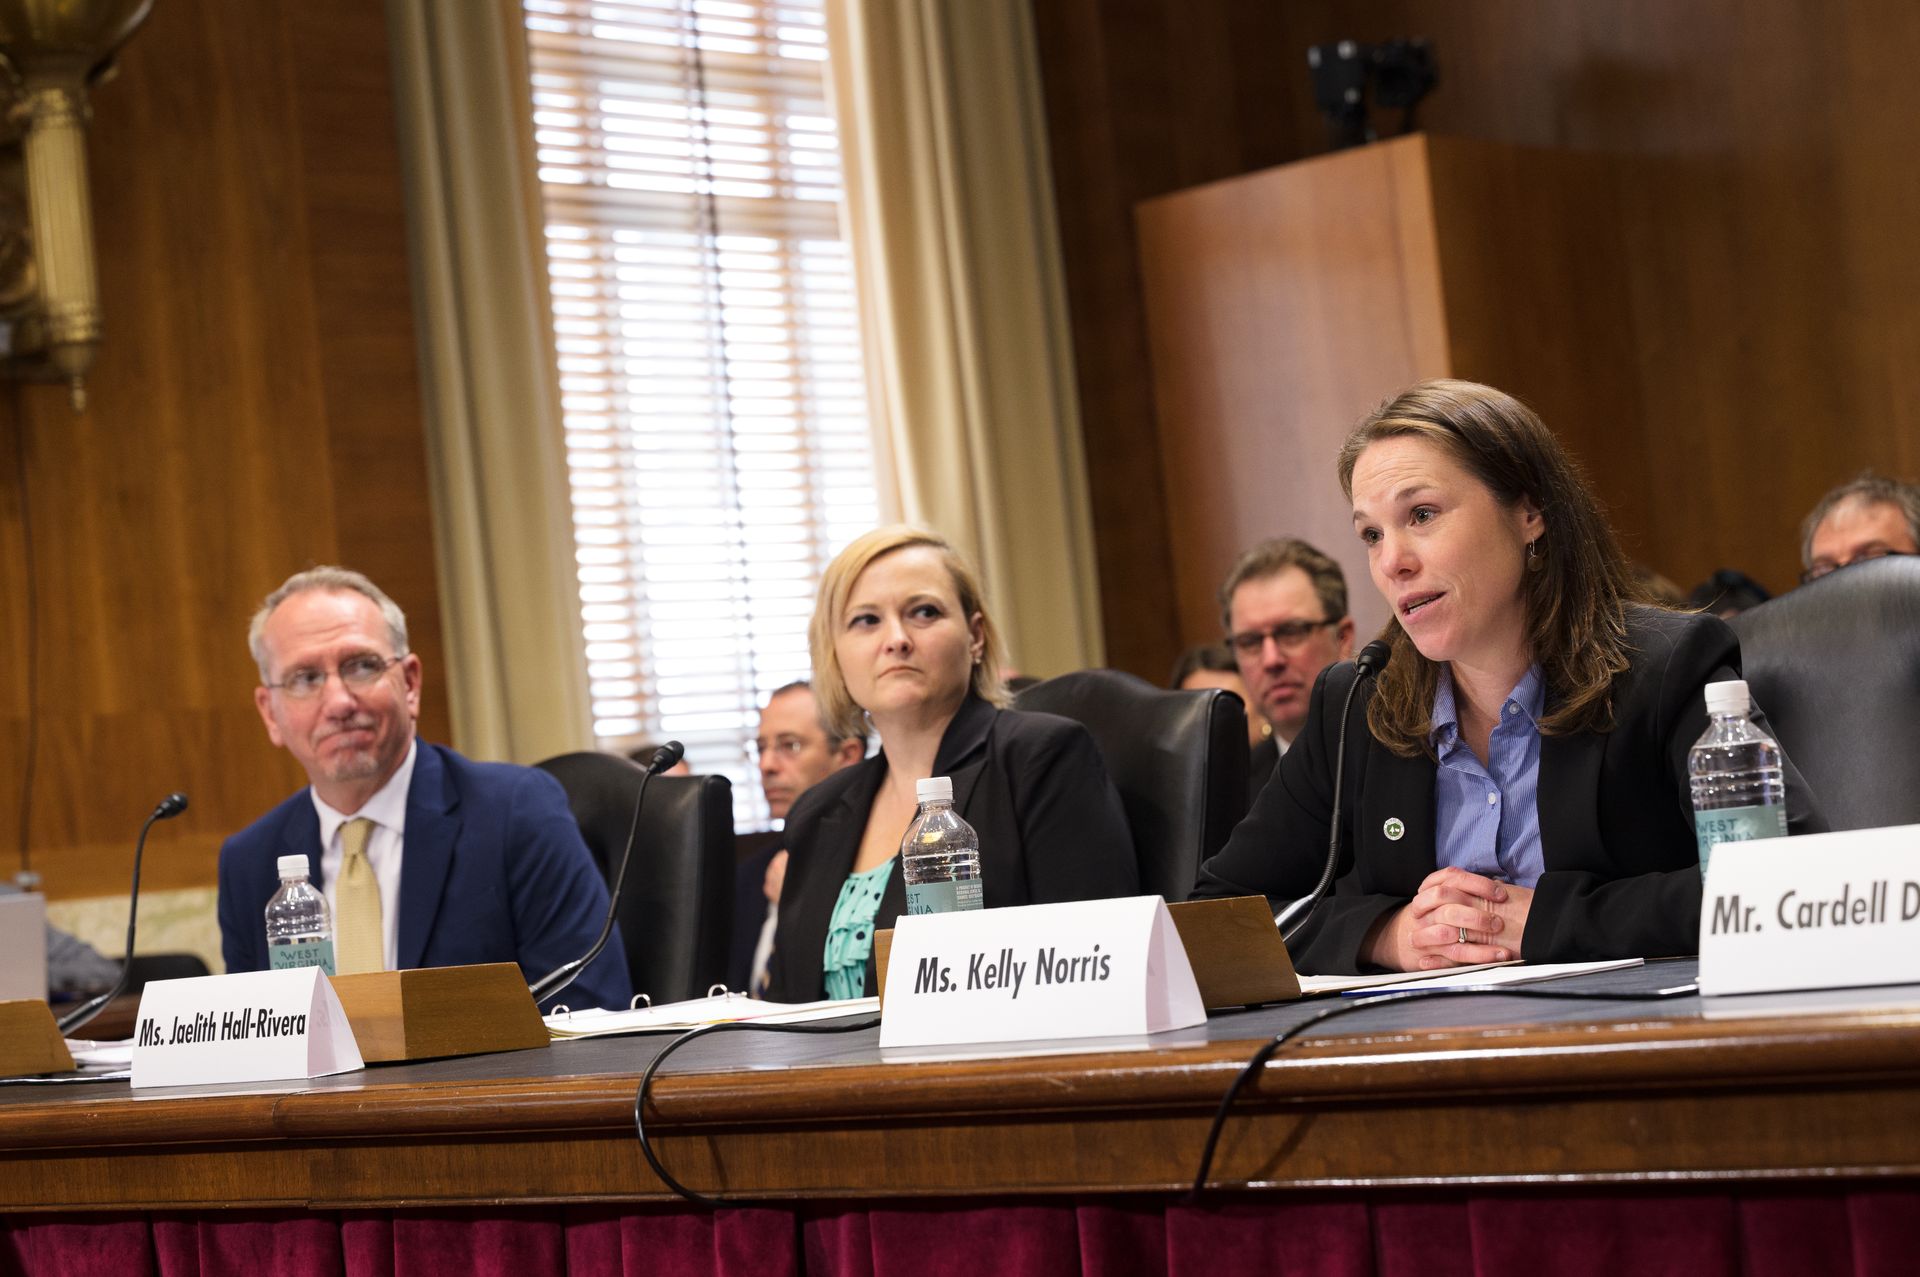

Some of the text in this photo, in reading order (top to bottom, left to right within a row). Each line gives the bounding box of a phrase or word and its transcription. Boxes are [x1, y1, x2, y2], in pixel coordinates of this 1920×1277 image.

[1711, 880, 1920, 935] Mr. Cardell D
[280, 948, 319, 960] WEST
[914, 944, 1111, 1000] Ms. Kelly Norris
[138, 1008, 306, 1047] Ms. Jaelith Hall-Rivera
